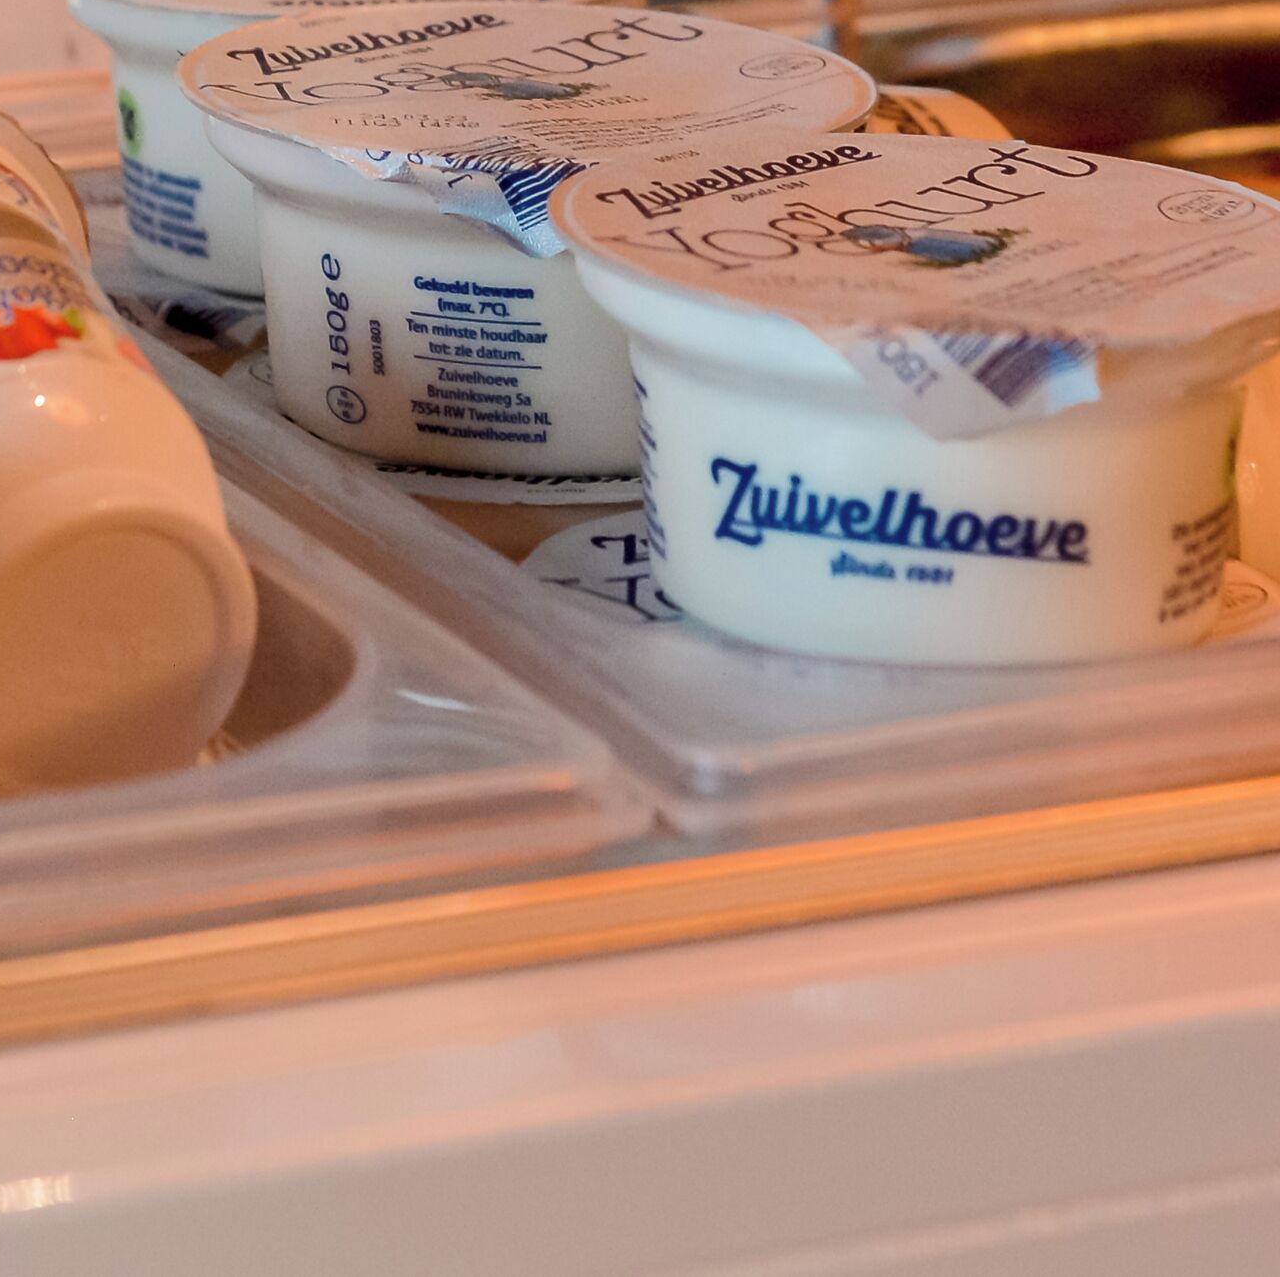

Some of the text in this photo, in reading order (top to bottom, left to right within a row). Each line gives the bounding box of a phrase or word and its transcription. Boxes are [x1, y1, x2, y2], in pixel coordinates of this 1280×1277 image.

[226, 12, 510, 76] Zuivelhoeve
[594, 143, 884, 220] Zuivelhoeve
[592, 146, 1100, 273] Yoghurt
[413, 275, 535, 300] Gekoeld bewaren
[437, 297, 476, 315] (max.
[325, 286, 352, 378] 150g
[405, 317, 548, 344] Ten minste houdbaar
[453, 343, 473, 357] zie
[475, 345, 526, 362] datum.
[437, 367, 519, 388] Zuivelhoeve
[426, 383, 512, 409] Bruninksweg
[410, 399, 553, 426] 7554 RW Twekkelo NL
[415, 423, 548, 445] www.zuivelhoeve.nl
[710, 456, 1092, 566] Zuivelhoeve
